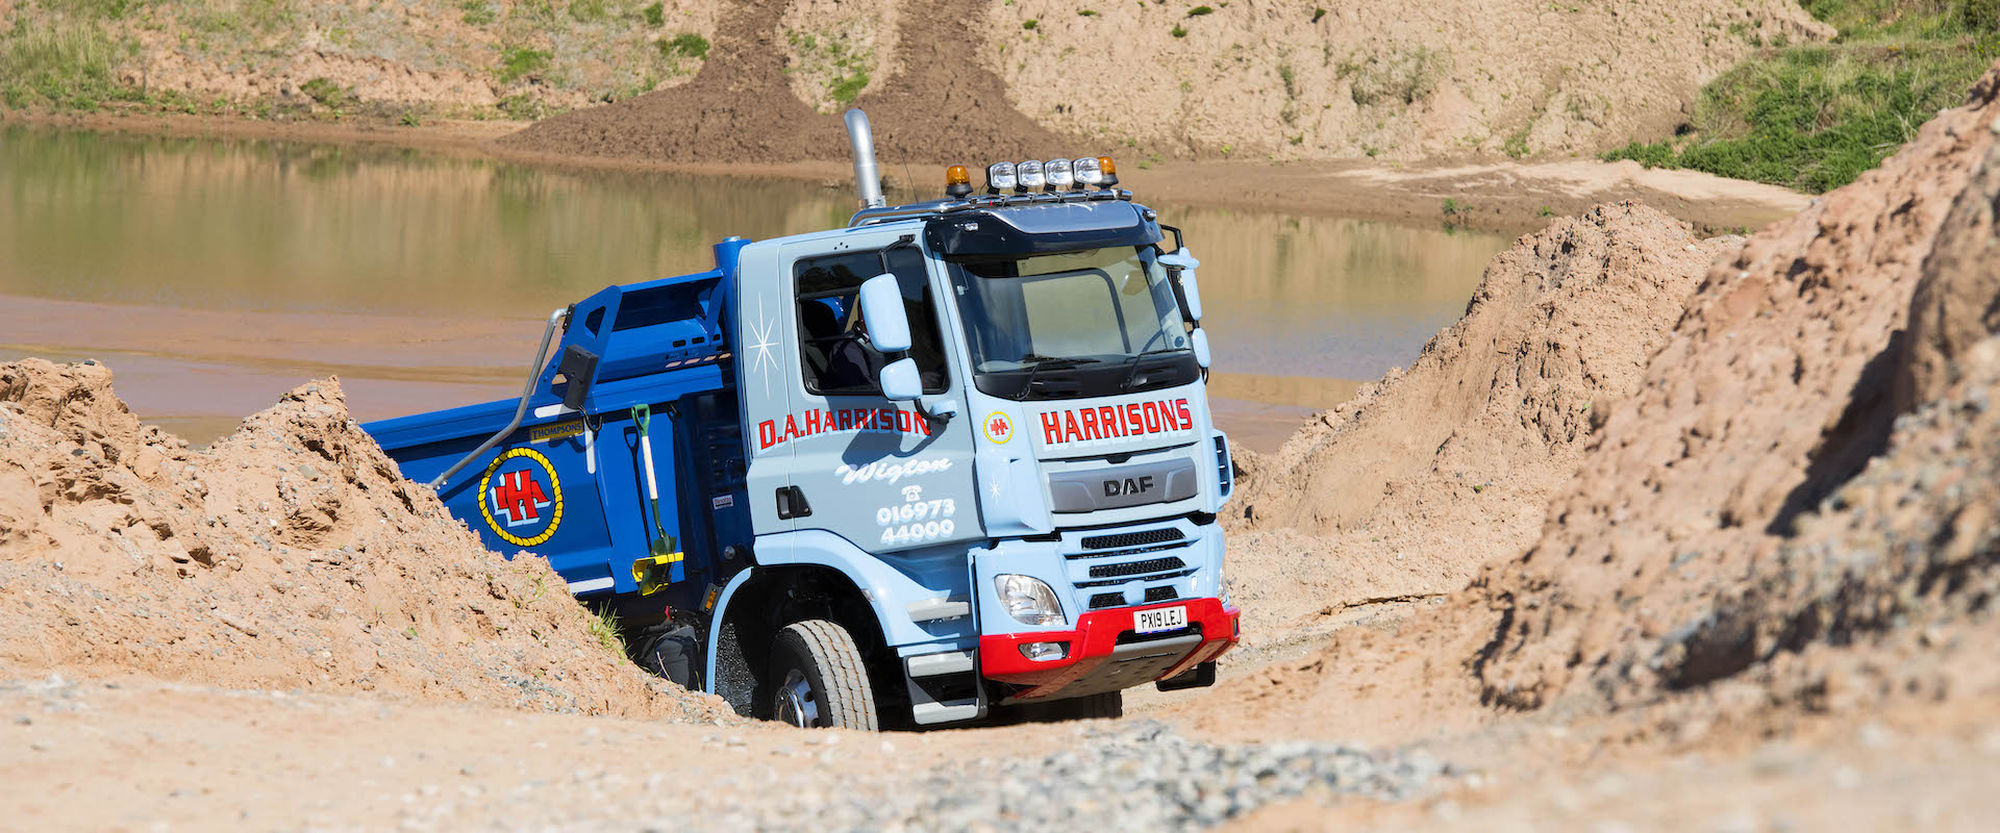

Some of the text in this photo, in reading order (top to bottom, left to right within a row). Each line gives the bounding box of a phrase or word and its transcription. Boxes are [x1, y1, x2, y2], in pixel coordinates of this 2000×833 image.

[533, 422, 582, 440] THOMPSONS
[1040, 398, 1193, 445] HARRISONS
[835, 458, 953, 485] Wigton
[1103, 475, 1155, 498] DAF
[876, 498, 956, 526] 016973
[881, 519, 955, 545] 44000
[1141, 609, 1182, 629] PX19 LEJ
